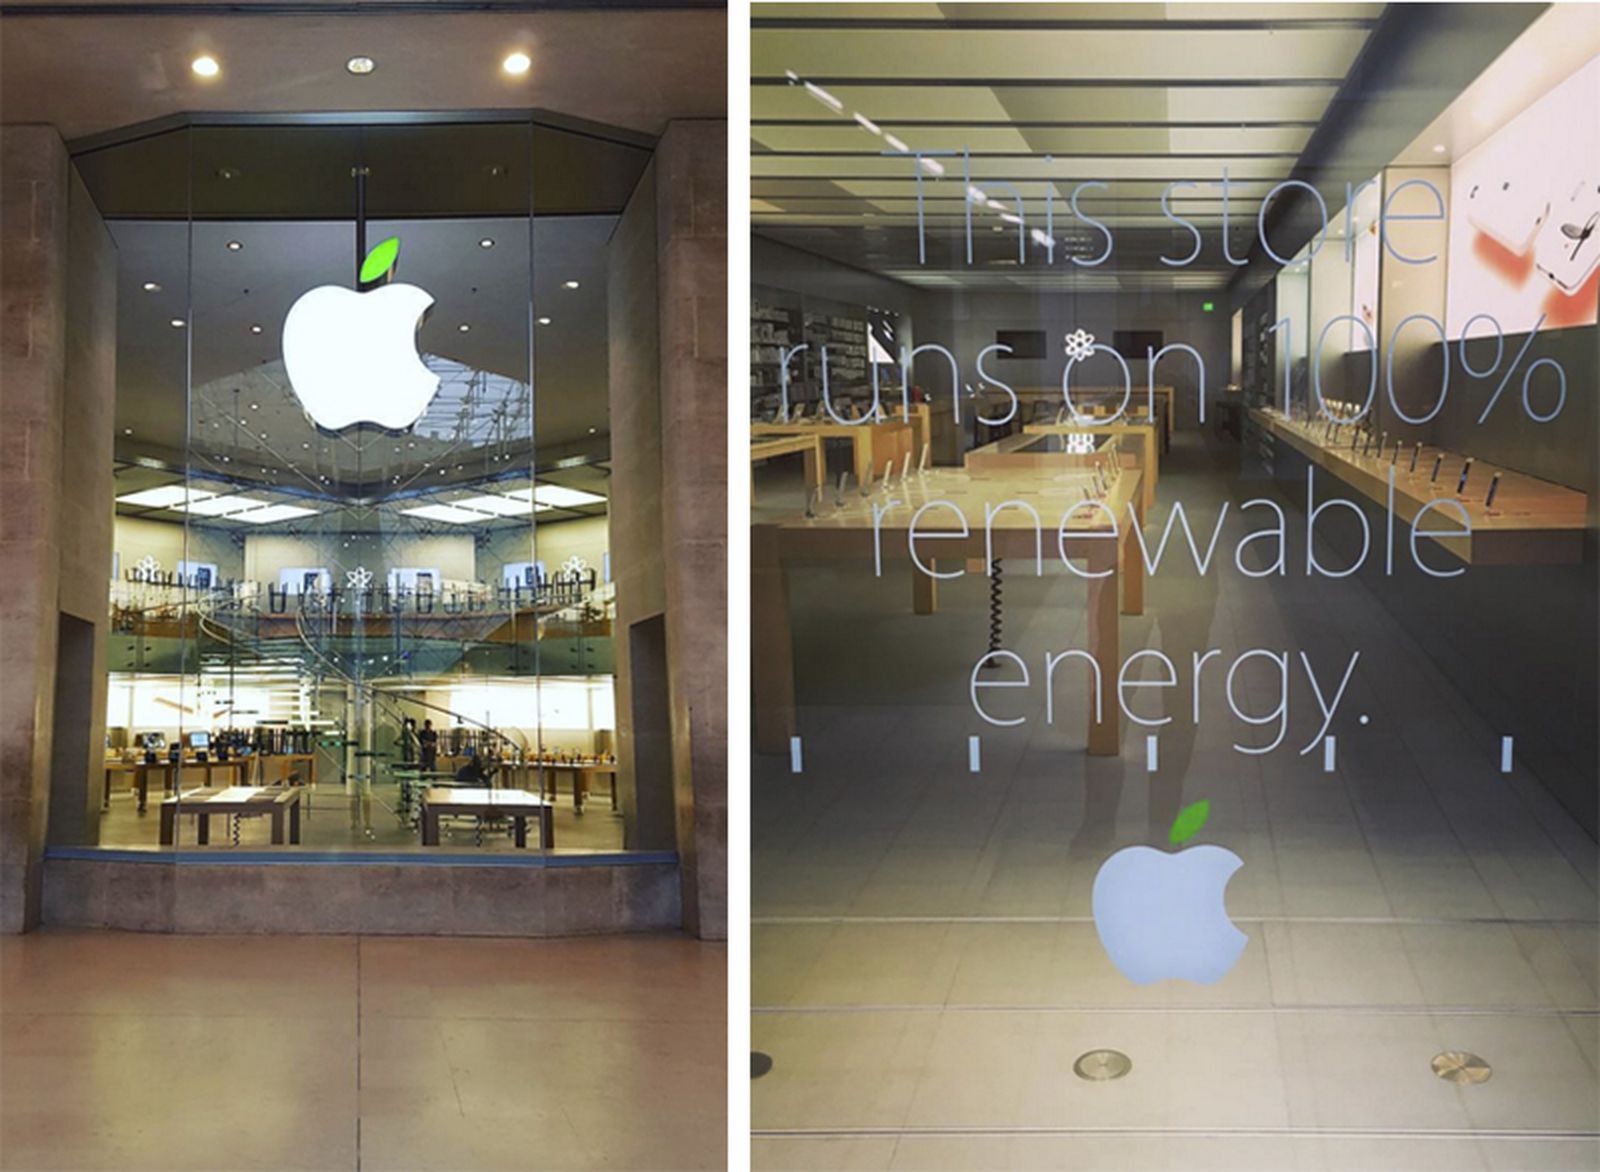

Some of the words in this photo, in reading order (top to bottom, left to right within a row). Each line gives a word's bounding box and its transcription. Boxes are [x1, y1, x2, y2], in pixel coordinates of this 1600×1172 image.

[881, 145, 1113, 265] This
[1160, 166, 1446, 266] store
[779, 343, 1018, 426] runs
[1062, 344, 1206, 426] on
[1270, 312, 1567, 426] 100%
[872, 464, 1473, 578] renewable
[969, 648, 1370, 756] energy.
